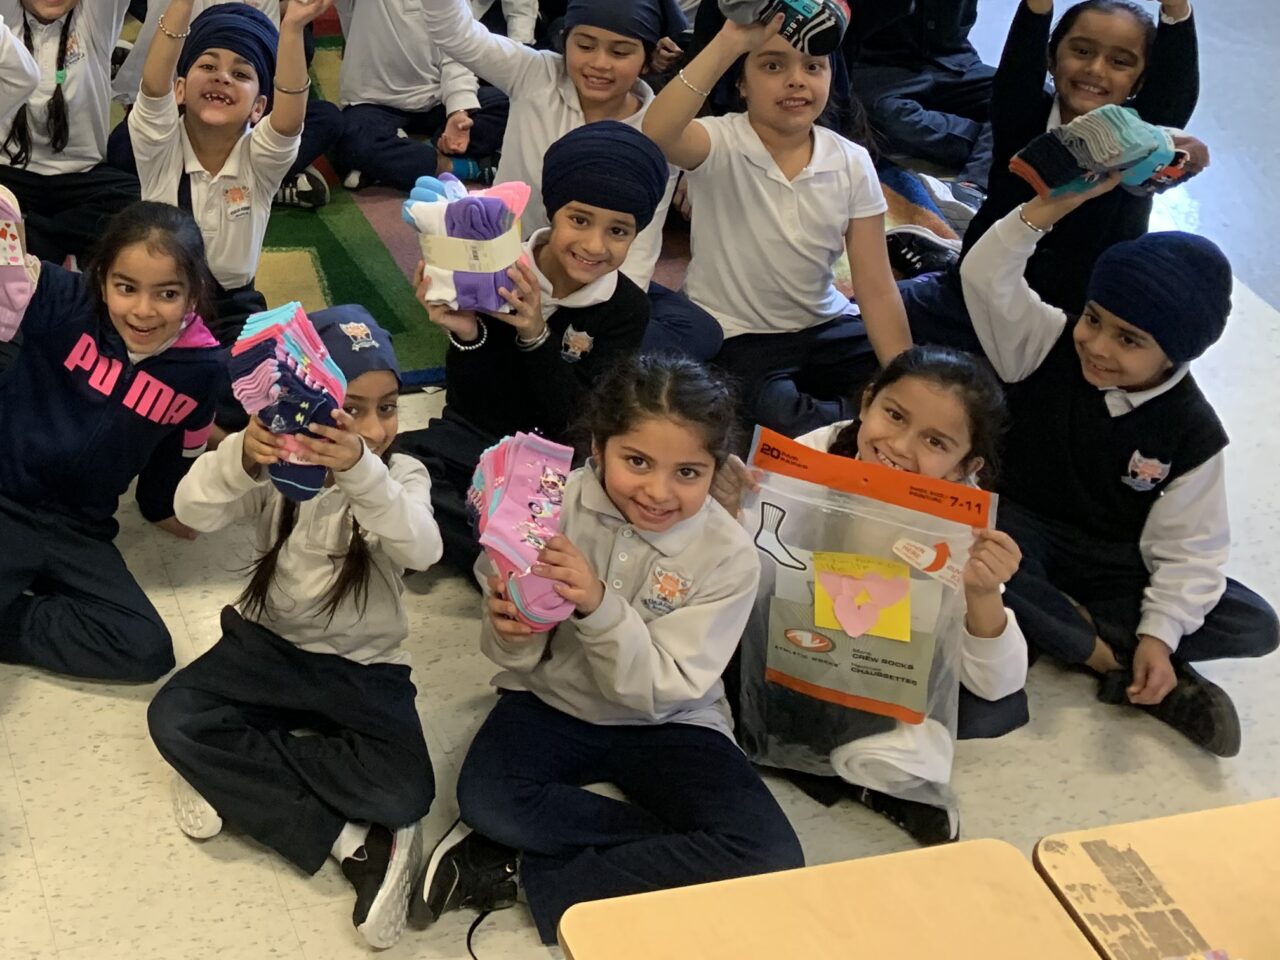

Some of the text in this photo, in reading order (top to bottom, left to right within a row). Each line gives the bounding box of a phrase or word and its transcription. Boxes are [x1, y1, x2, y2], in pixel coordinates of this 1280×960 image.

[63, 332, 199, 425] PUMA
[760, 443, 780, 460] 20
[950, 496, 982, 514] 7-11
[852, 653, 879, 663] CREW
[881, 658, 915, 670] SOCKS
[851, 666, 917, 686] CHAUSSETTES
